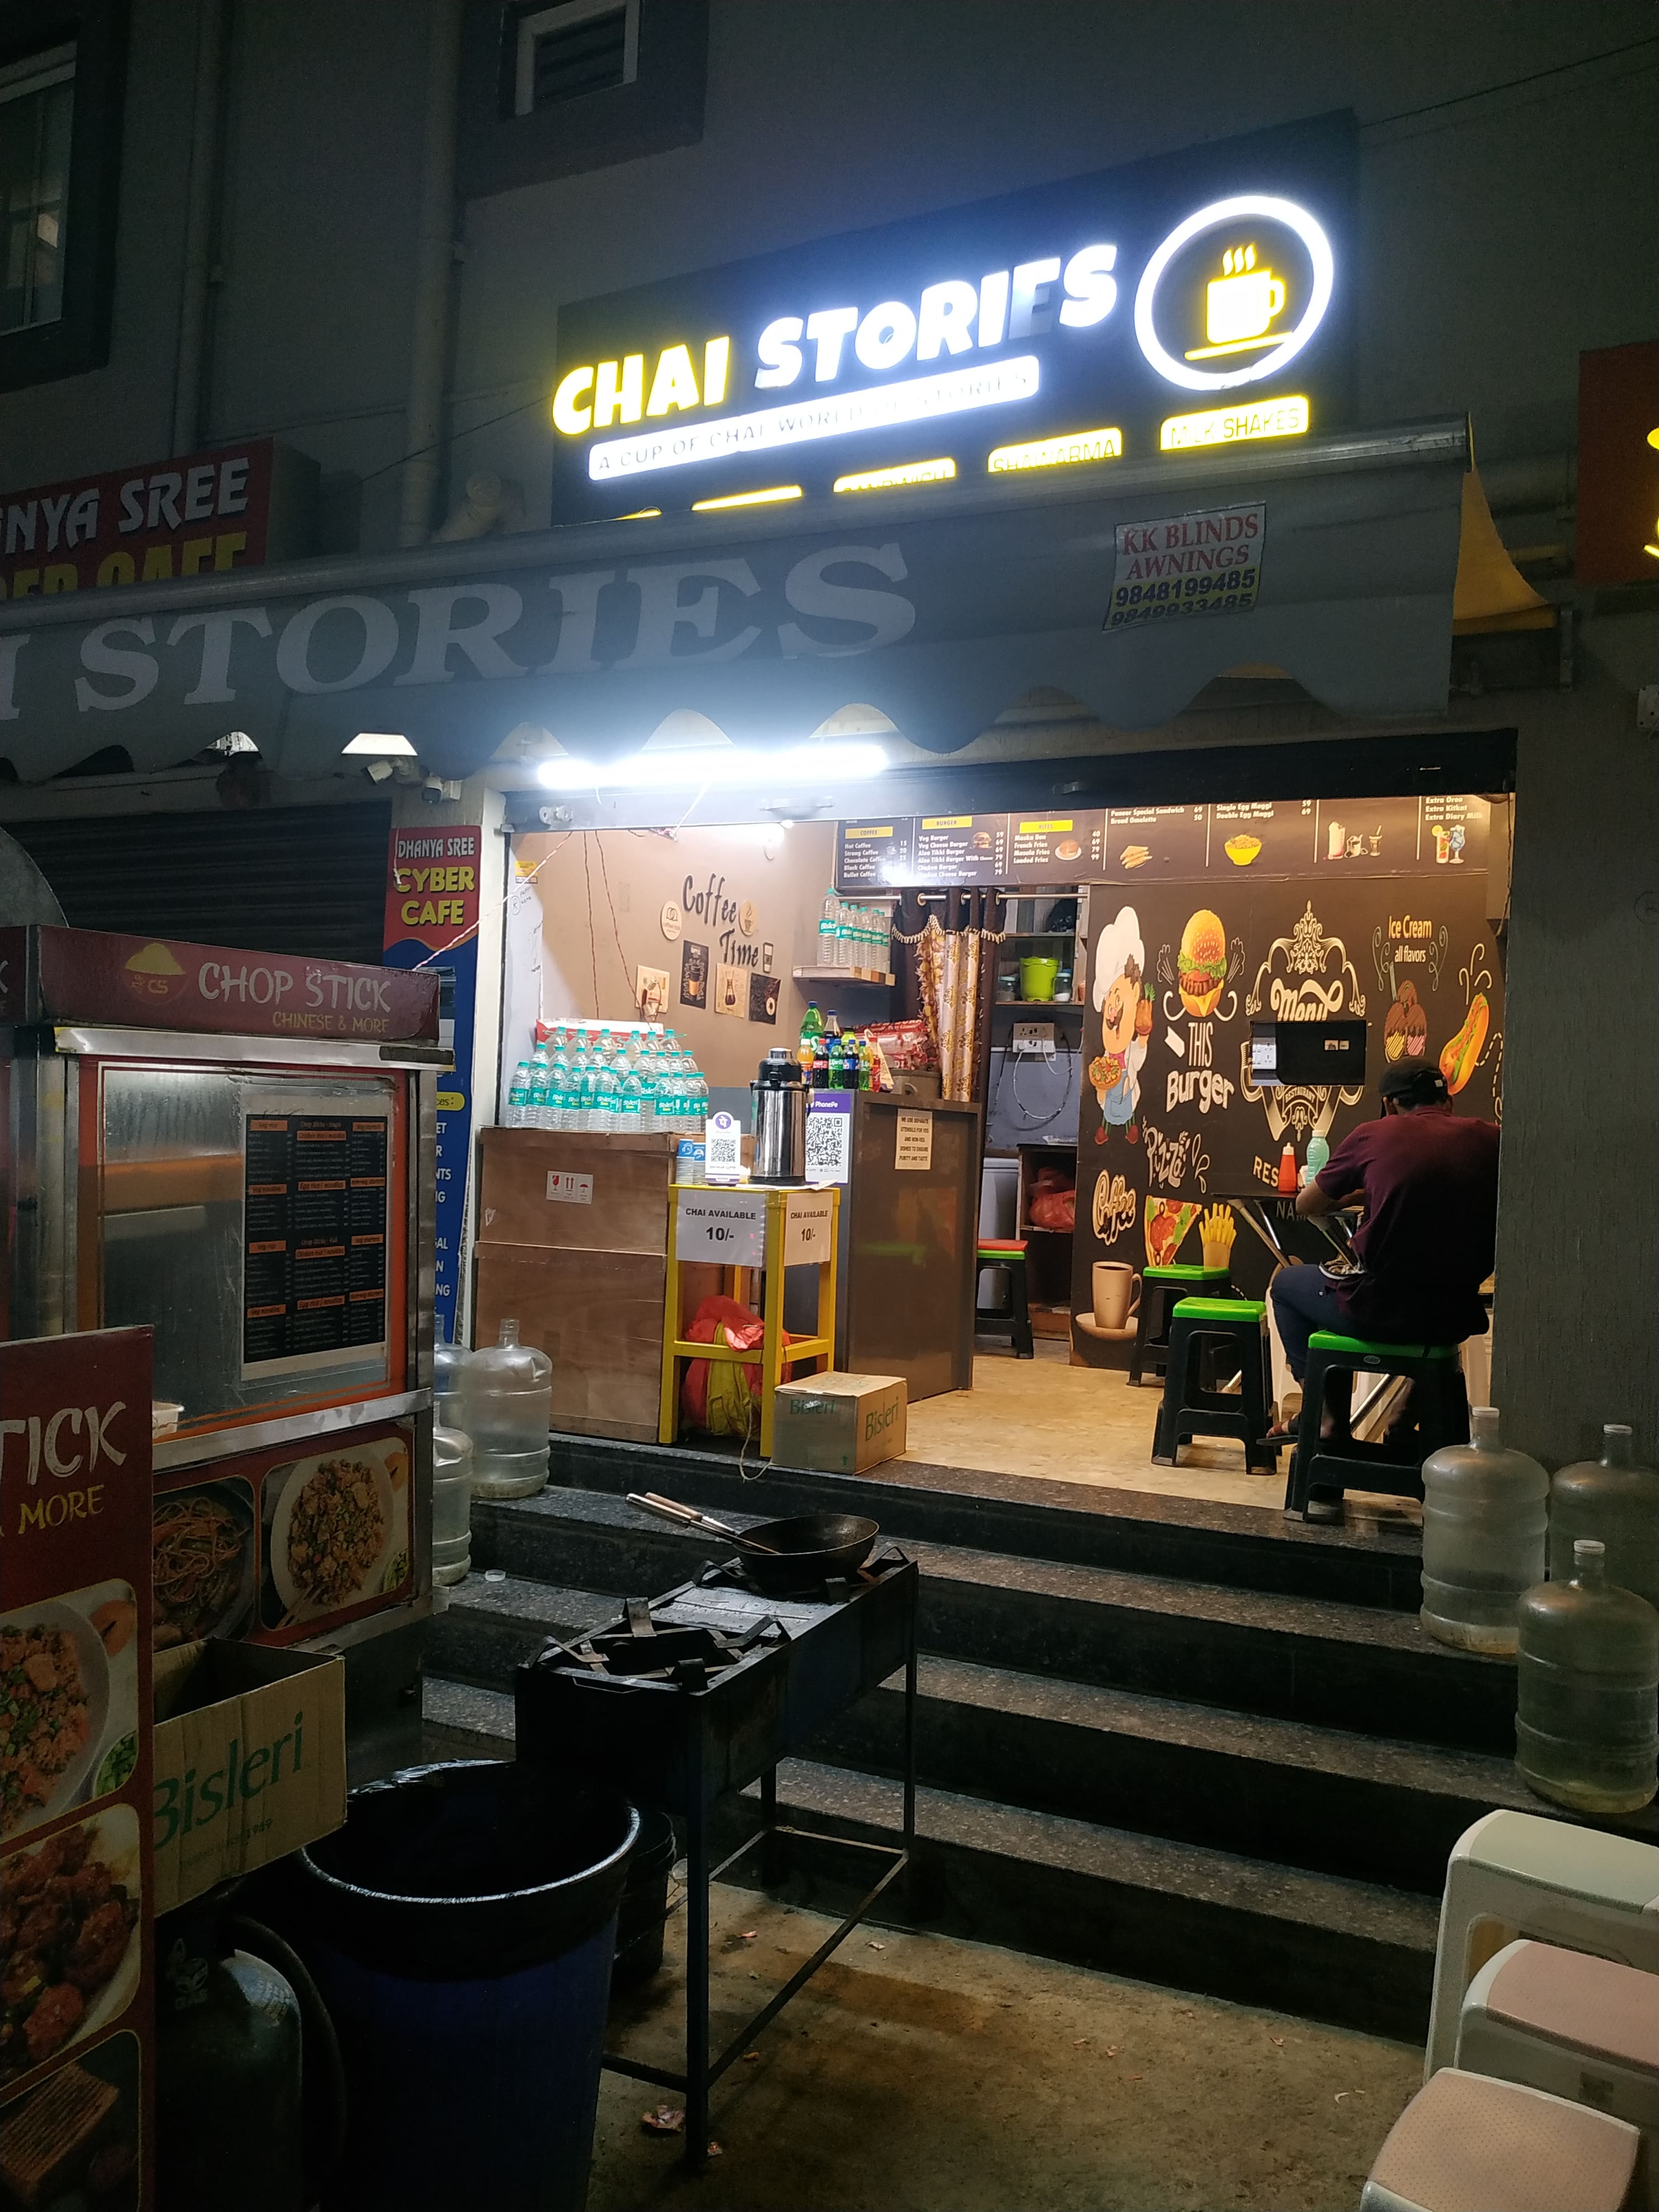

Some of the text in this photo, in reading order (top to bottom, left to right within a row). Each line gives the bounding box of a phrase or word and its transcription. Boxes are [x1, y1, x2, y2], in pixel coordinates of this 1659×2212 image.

[553, 246, 1117, 435] CHAI STORIES
[599, 456, 610, 470] A
[620, 446, 662, 467] CUP
[673, 436, 698, 456] OF
[710, 424, 766, 447] CHAI
[779, 405, 862, 433] WORLD
[919, 372, 1029, 407] STORIES
[1171, 408, 1299, 448] MILK SHAKES
[0, 457, 249, 555] NYA SREE
[1123, 513, 1259, 555] KK BLINDS
[1125, 544, 1249, 580] AWNINGS
[1116, 568, 1255, 607] 9848199485
[74, 542, 916, 712] STORIES
[1133, 808, 1155, 816] Special
[1238, 804, 1250, 812] Egg
[1251, 802, 1272, 810] Maggi
[1239, 811, 1252, 819] Egg
[1253, 810, 1274, 818] Maggi
[398, 837, 475, 859] DHANYA SREE
[394, 866, 475, 893] CYBER
[401, 900, 464, 925] CAFE
[683, 872, 737, 927] Coffee
[1389, 915, 1432, 939] Ice Cream
[719, 928, 759, 967] Time
[1394, 945, 1426, 963] all flavors
[147, 979, 168, 994] CS
[199, 962, 392, 1013] CHOP STICK
[272, 1010, 390, 1034] CHINESE & MORE
[1188, 1021, 1214, 1067] THIS
[1166, 1071, 1235, 1114] Burger
[1145, 1126, 1189, 1188] Pizza
[686, 1208, 757, 1220] CHAI AVAILABLE
[804, 1210, 828, 1218] AVAILABLE
[1093, 1168, 1136, 1246] Coffee
[706, 1226, 734, 1241] 10/-
[801, 1227, 816, 1242] 10/-
[790, 1399, 836, 1415] Bisleri
[865, 1396, 899, 1442] Bisleri
[18, 1484, 105, 1535] MORE
[153, 1710, 304, 1851] Bisleri
